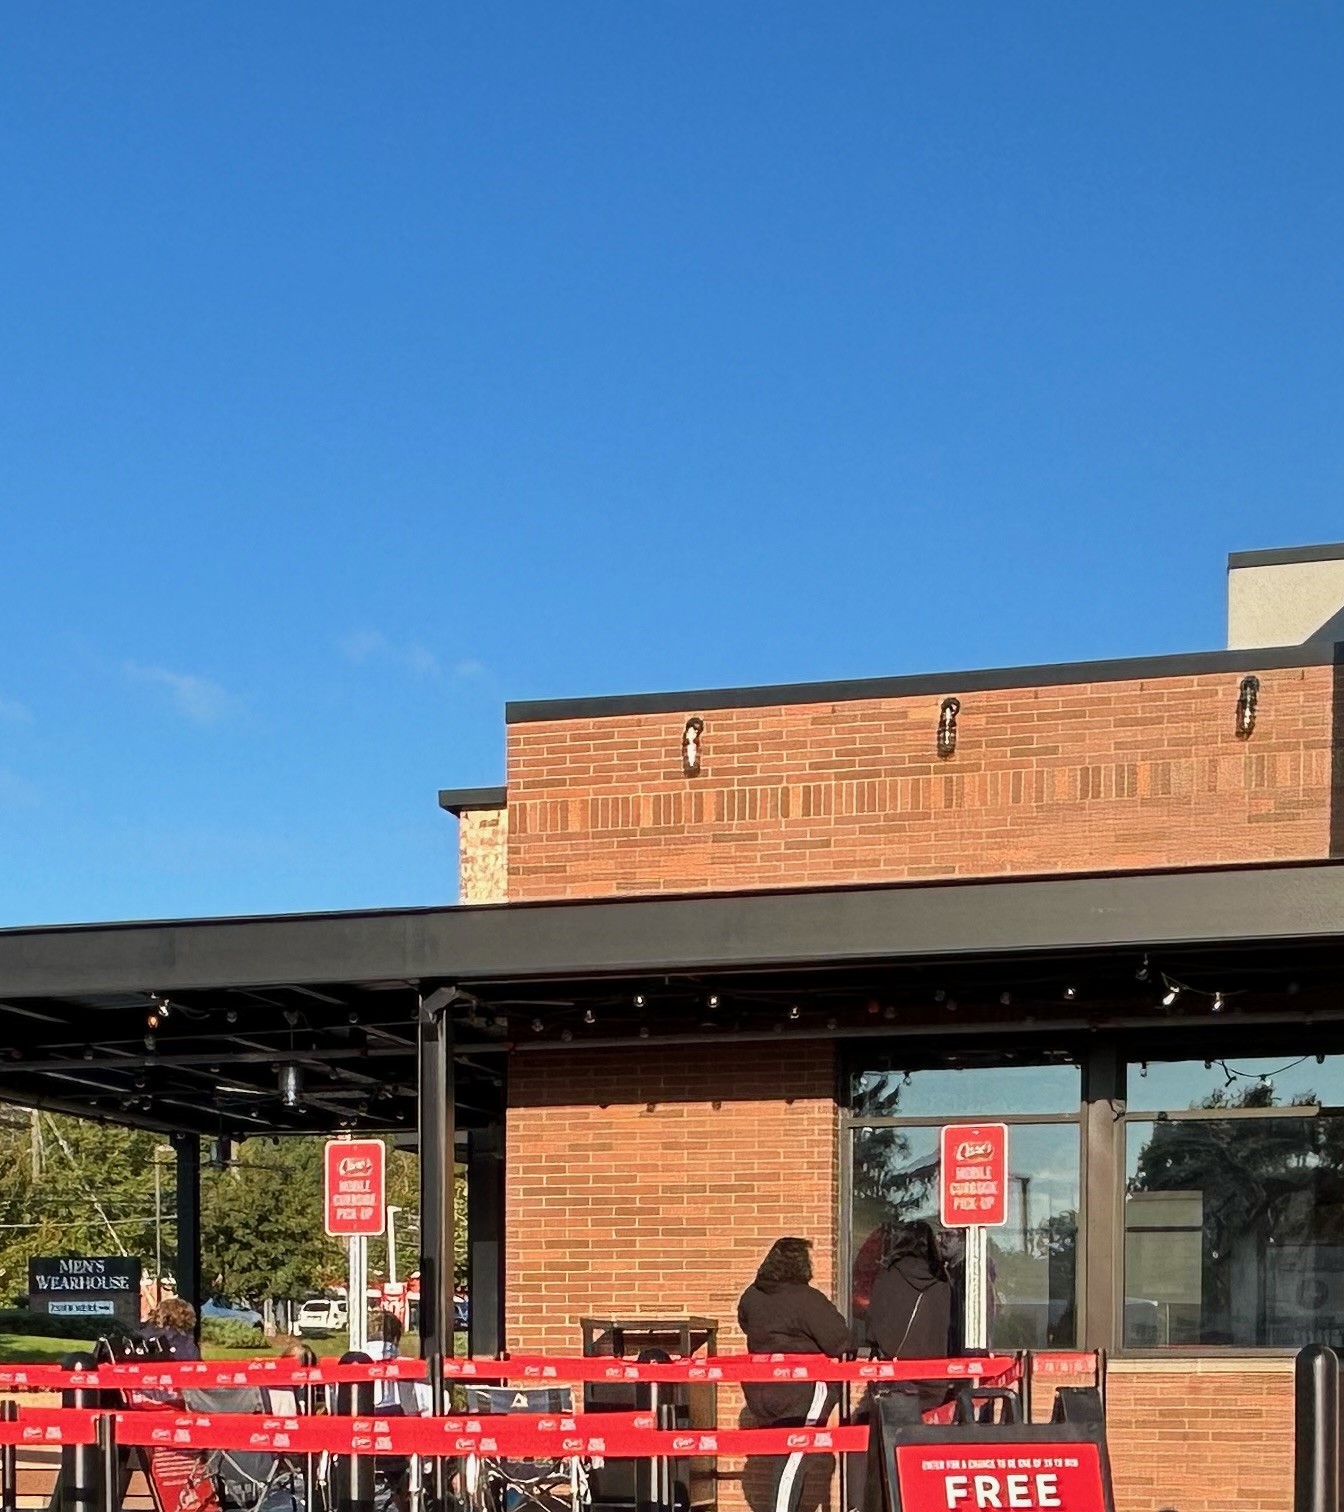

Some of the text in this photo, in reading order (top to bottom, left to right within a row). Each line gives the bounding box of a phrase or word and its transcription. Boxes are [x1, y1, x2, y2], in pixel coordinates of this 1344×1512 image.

[59, 1259, 105, 1274] MEN'S
[36, 1275, 130, 1290] WEARHOUSE
[945, 1474, 1062, 1509] FREE
